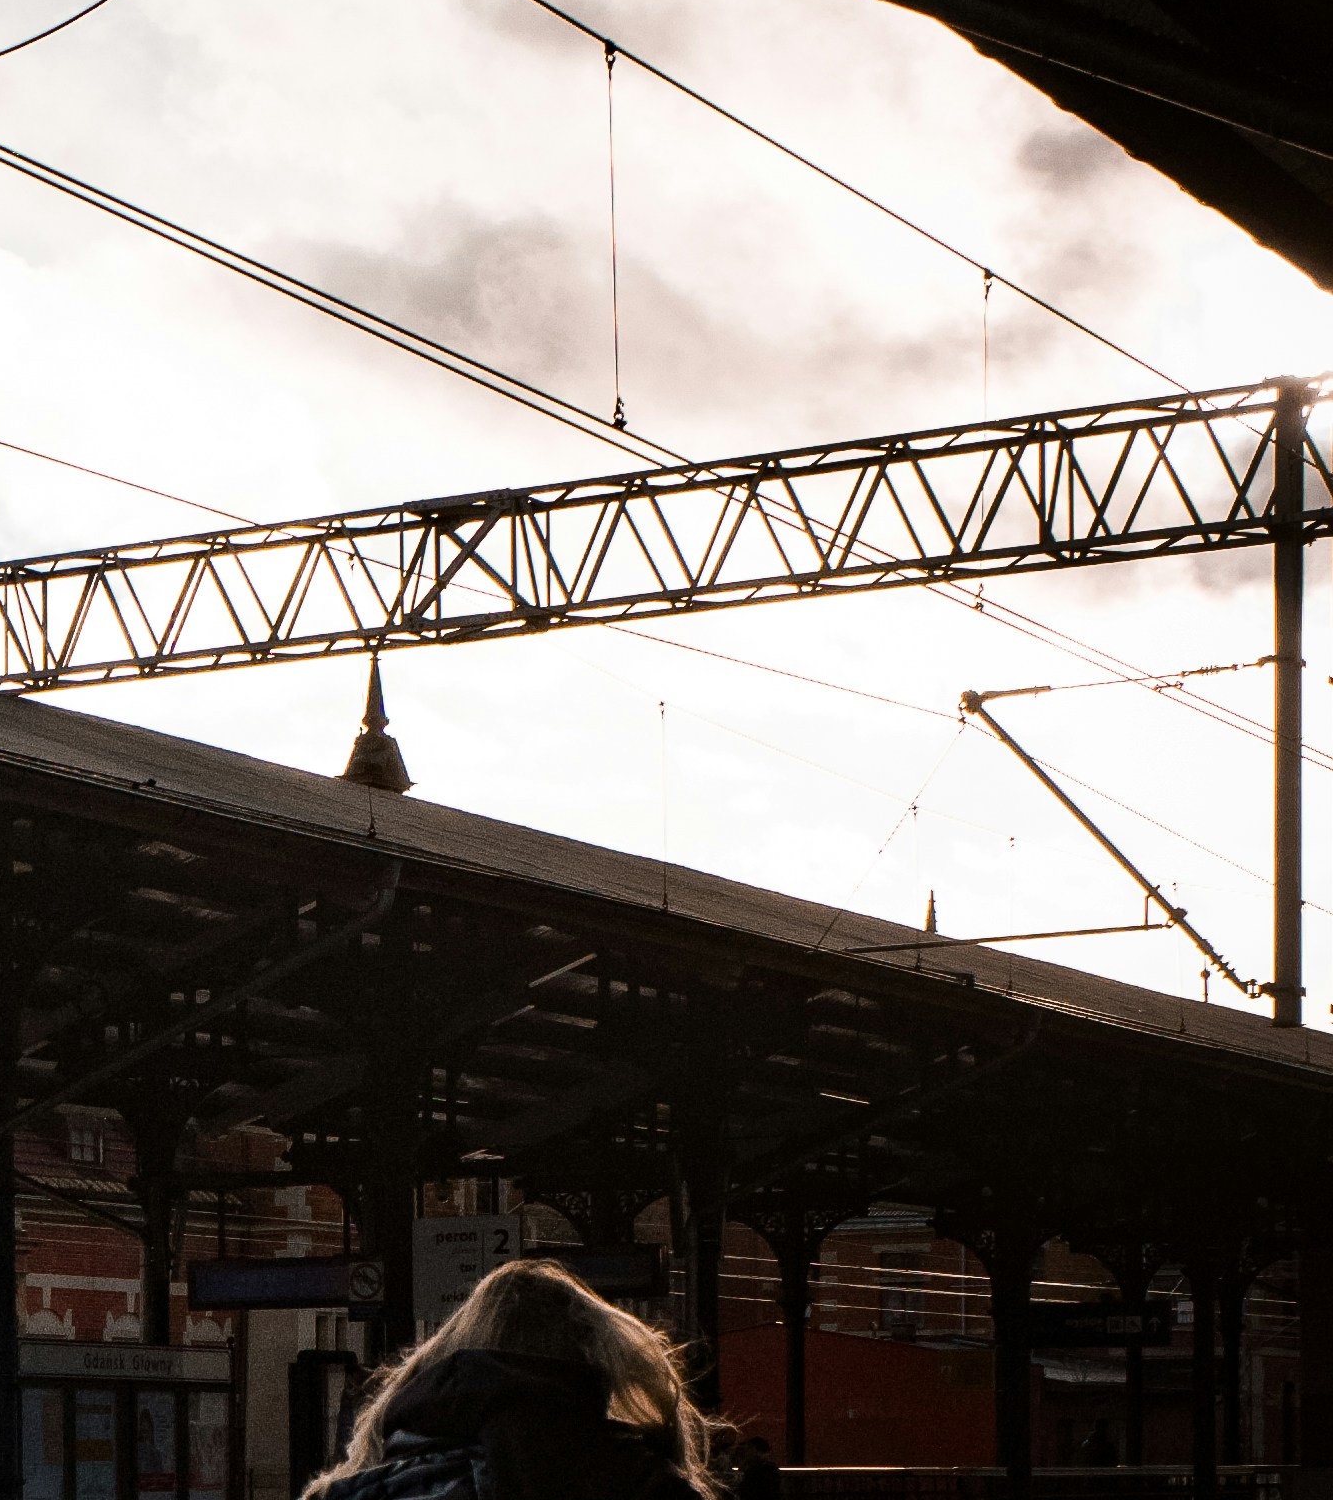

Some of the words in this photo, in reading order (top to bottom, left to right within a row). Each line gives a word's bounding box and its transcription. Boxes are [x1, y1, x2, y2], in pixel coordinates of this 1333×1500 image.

[435, 1231, 477, 1246] peron
[493, 1228, 510, 1255] 2
[459, 1262, 477, 1273] tor
